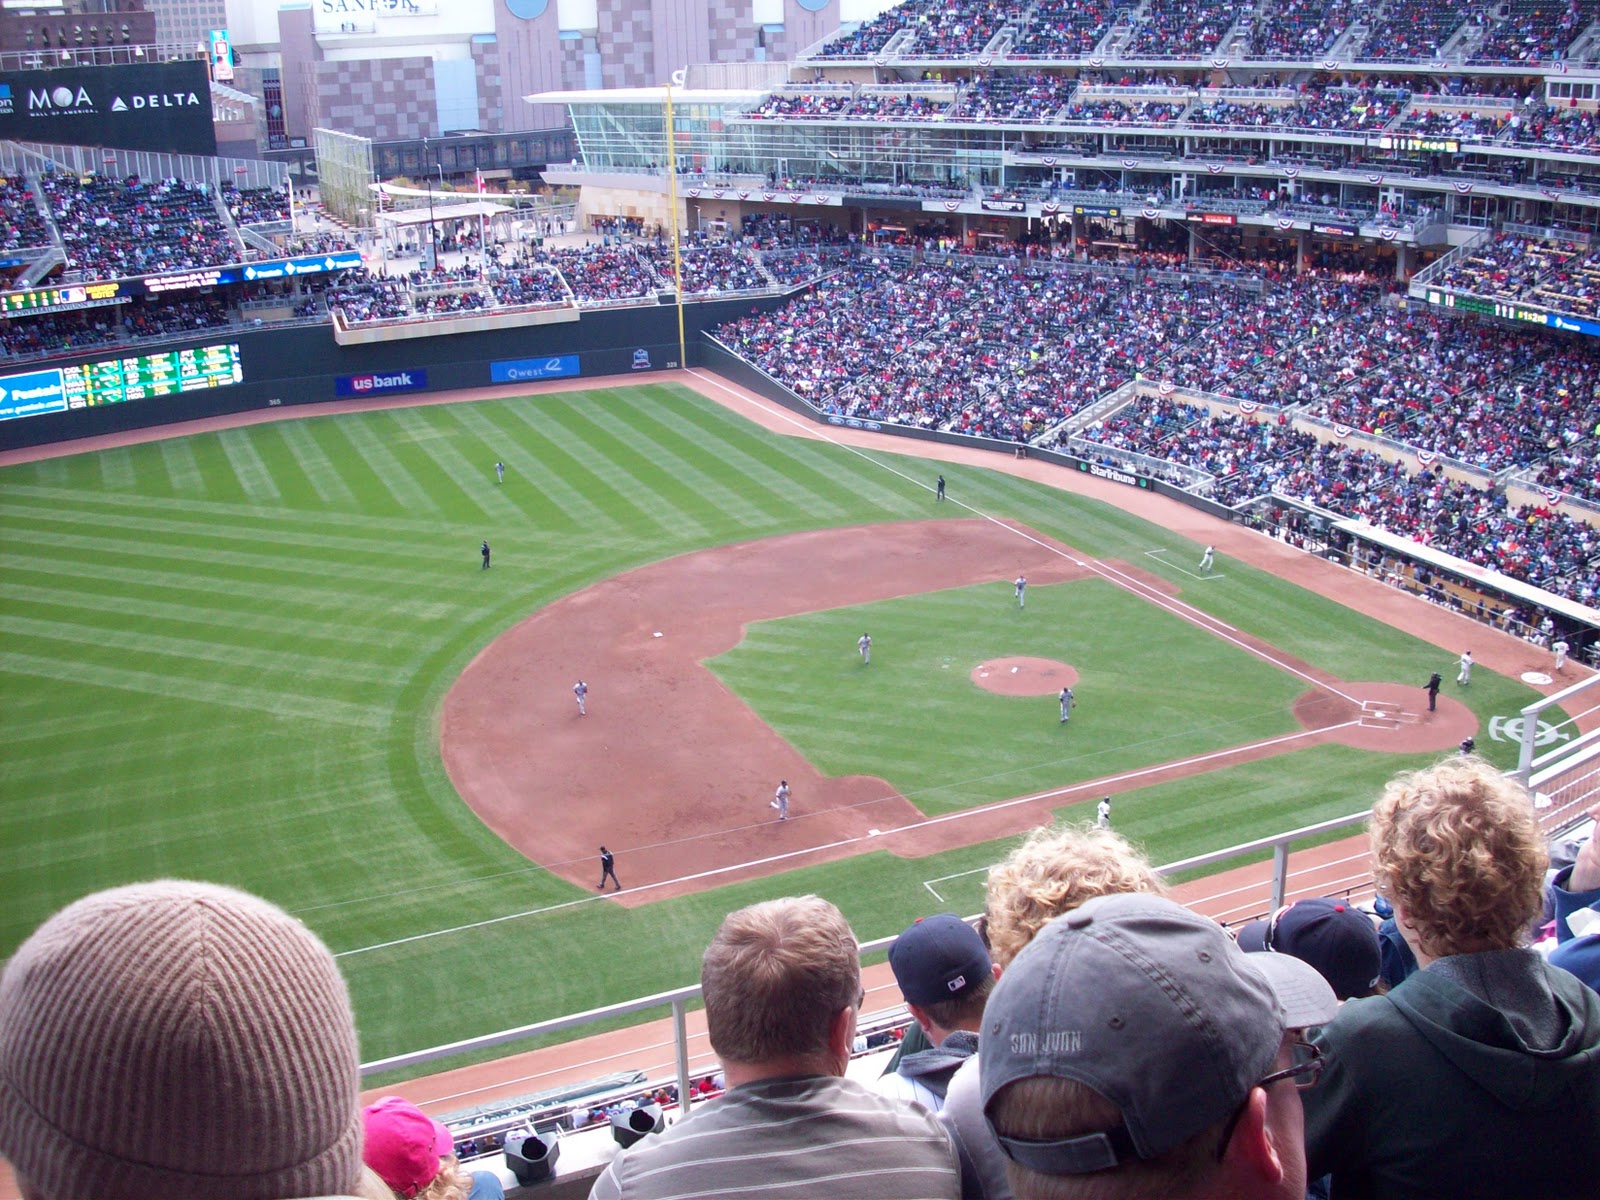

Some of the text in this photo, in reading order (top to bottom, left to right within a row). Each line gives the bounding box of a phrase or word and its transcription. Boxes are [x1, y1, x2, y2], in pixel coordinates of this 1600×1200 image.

[133, 92, 200, 108] DELTA
[56, 302, 88, 312] PAVILION
[508, 368, 543, 379] Qwest
[1090, 464, 1137, 485] StarTribune
[1010, 1030, 1082, 1054] SAN JUAN
